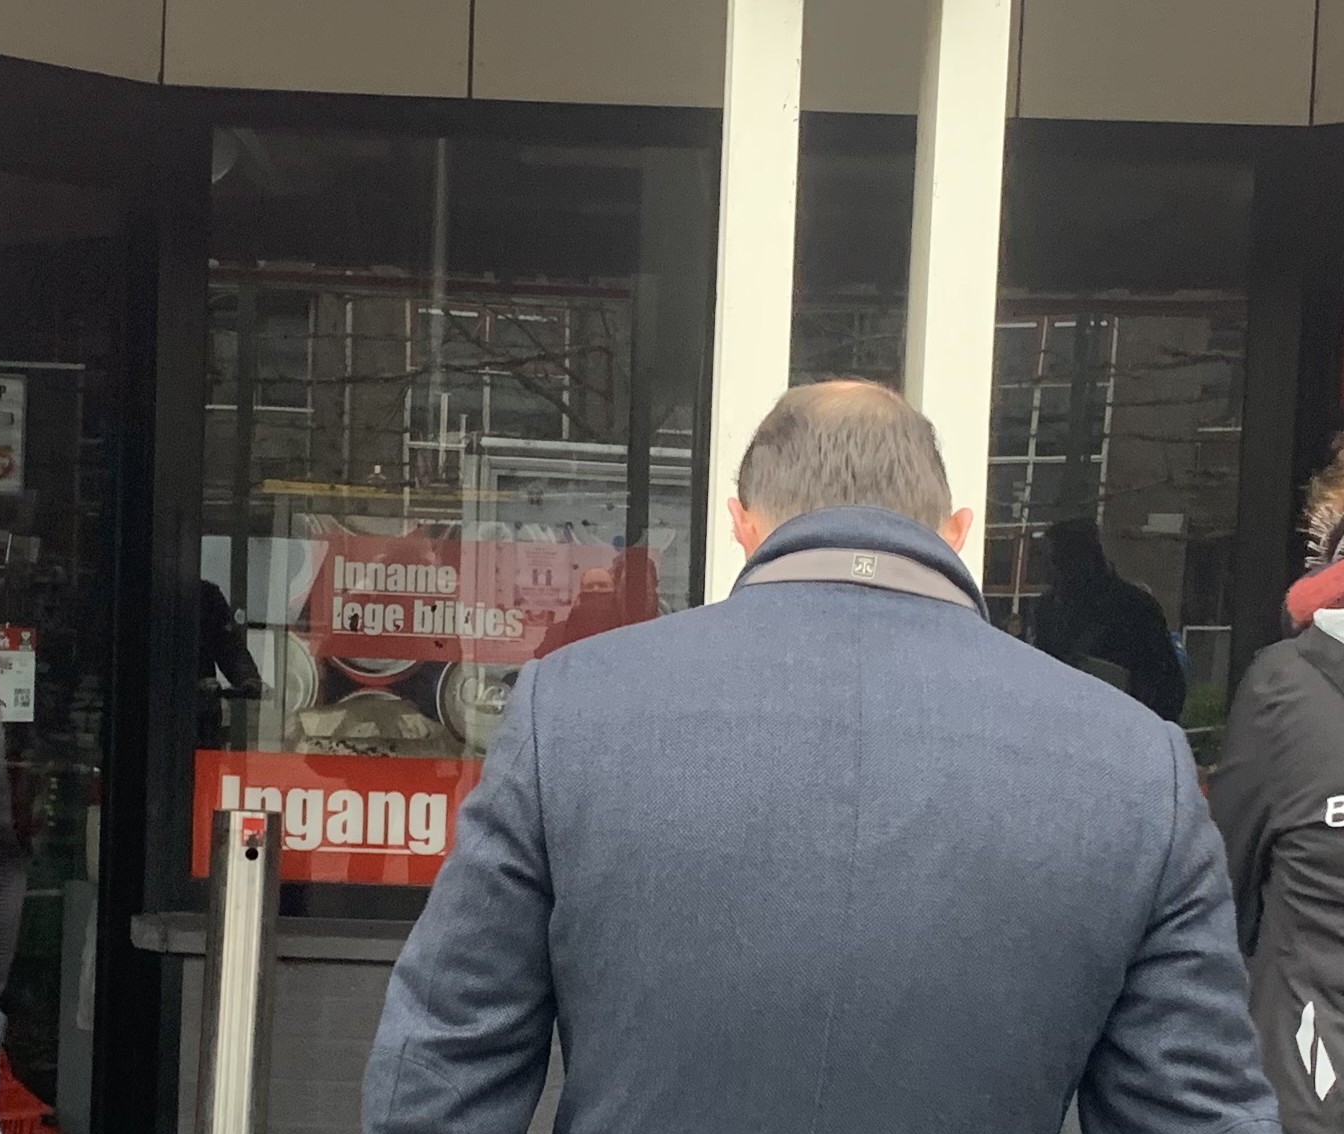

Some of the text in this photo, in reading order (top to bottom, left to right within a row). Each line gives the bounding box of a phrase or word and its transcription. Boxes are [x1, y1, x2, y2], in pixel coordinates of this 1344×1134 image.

[333, 555, 456, 594] Inname
[332, 596, 524, 639] lege blikjes
